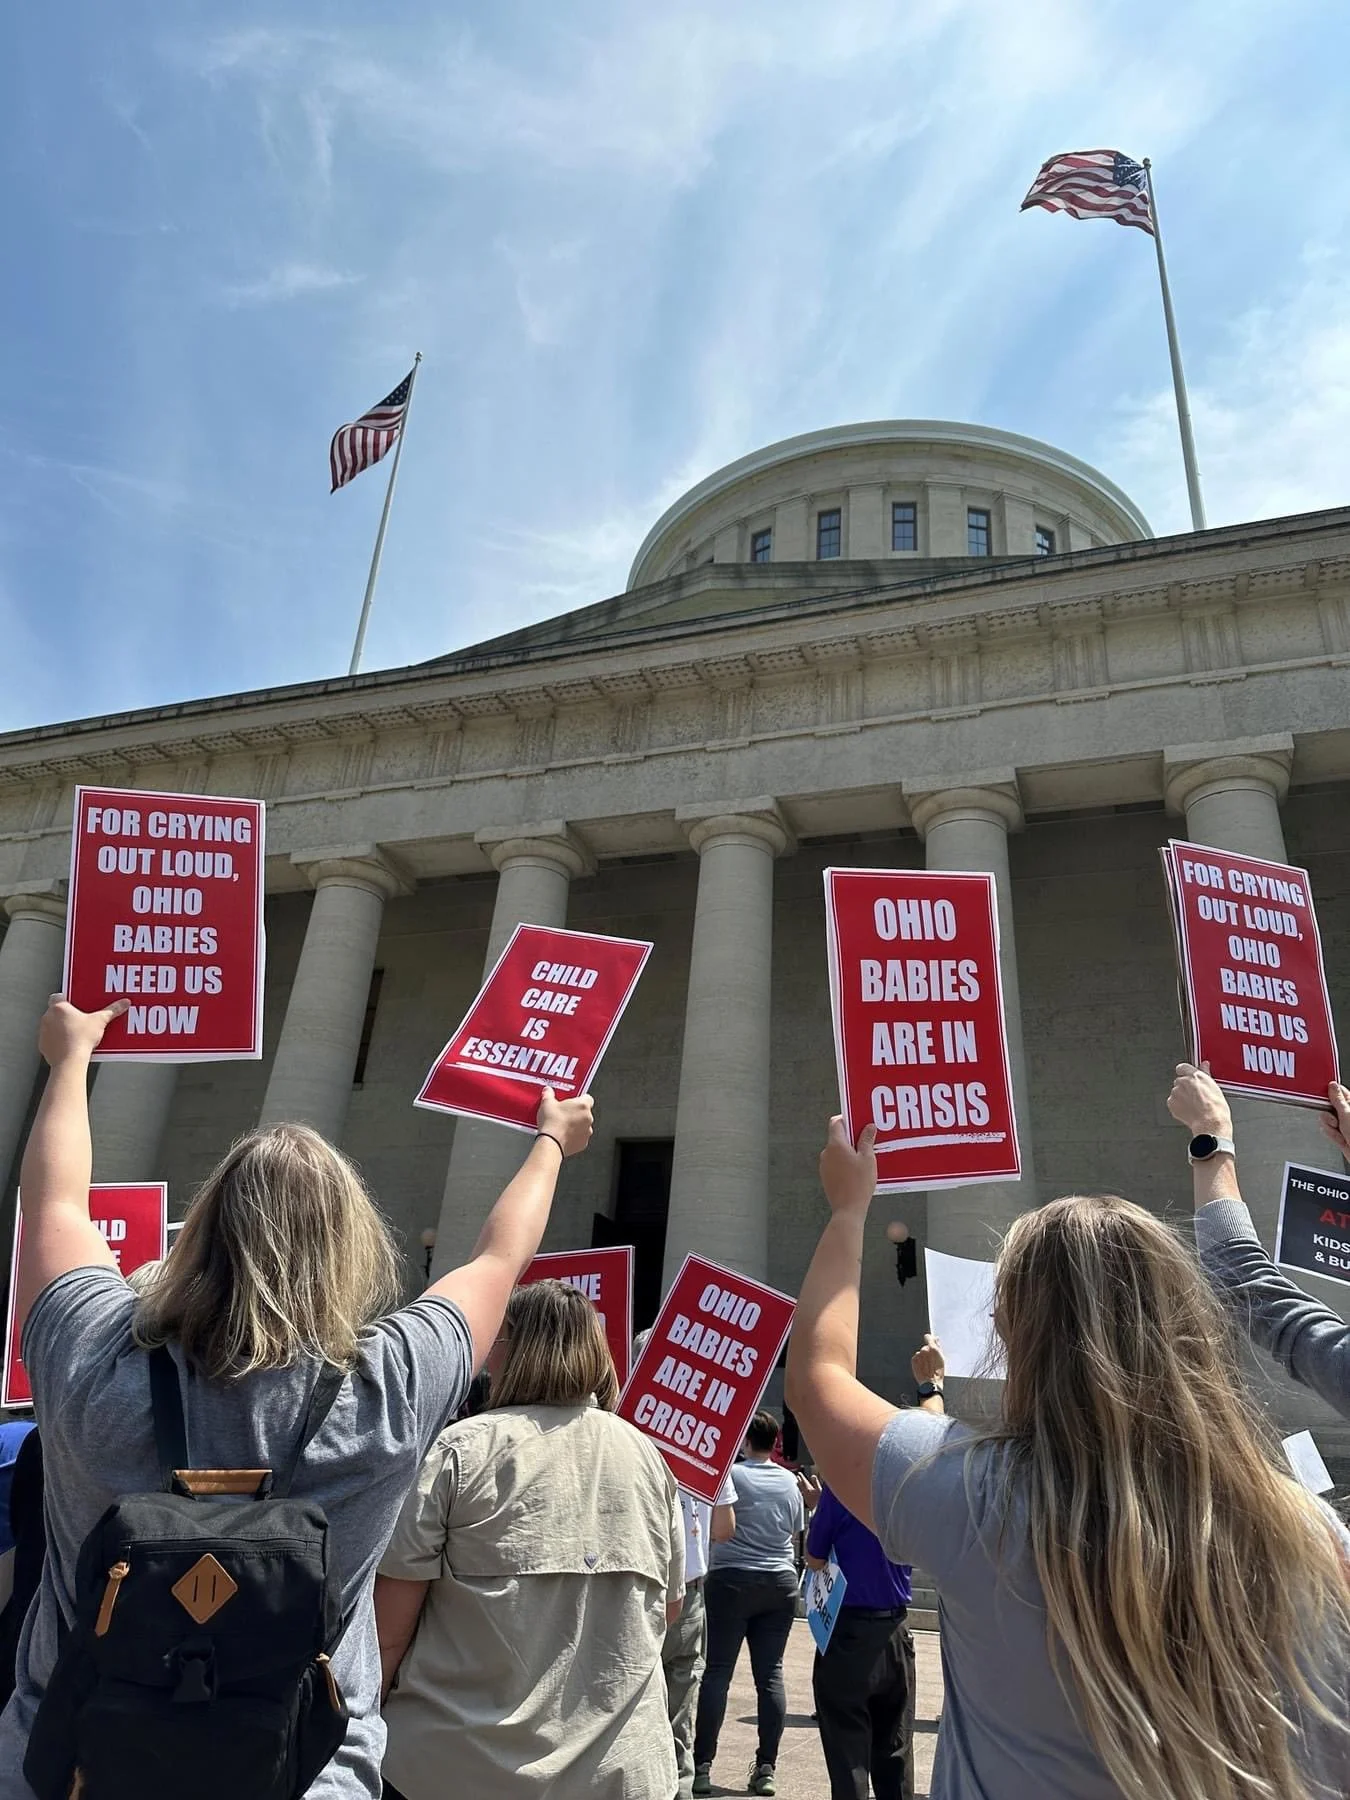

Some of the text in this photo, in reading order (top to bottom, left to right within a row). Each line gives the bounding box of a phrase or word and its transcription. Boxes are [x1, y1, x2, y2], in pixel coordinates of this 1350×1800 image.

[87, 807, 252, 843] FOR CRYING
[97, 846, 240, 882] OUT LOUD,
[132, 886, 203, 915] OHIO
[1182, 860, 1306, 907] FOR CRYING
[874, 898, 956, 941] OHIO
[1197, 895, 1303, 941] OUT LOUD,
[113, 924, 218, 955] BABIES
[1228, 935, 1281, 969] OHIO
[105, 964, 223, 994] NEED US
[530, 961, 598, 989] CHILD
[860, 959, 980, 1002] BABIES
[1220, 967, 1299, 1006] BABIES
[127, 1005, 199, 1034] NOW
[520, 988, 581, 1016] CARE
[520, 1017, 550, 1041] IS
[1220, 1003, 1309, 1044] NEED US
[459, 1036, 579, 1080] ESSENTIAL
[872, 1020, 977, 1066] ARE IN
[1242, 1043, 1295, 1078] NOW
[870, 1082, 990, 1132] CRISIS
[1290, 1178, 1349, 1200] THE OHIO
[1313, 1233, 1350, 1254] KIDS
[1314, 1251, 1325, 1263] &
[698, 1283, 761, 1331] OHIO
[666, 1313, 758, 1378] BABIES
[652, 1355, 737, 1416] ARE IN
[633, 1393, 721, 1459] CRISIS
